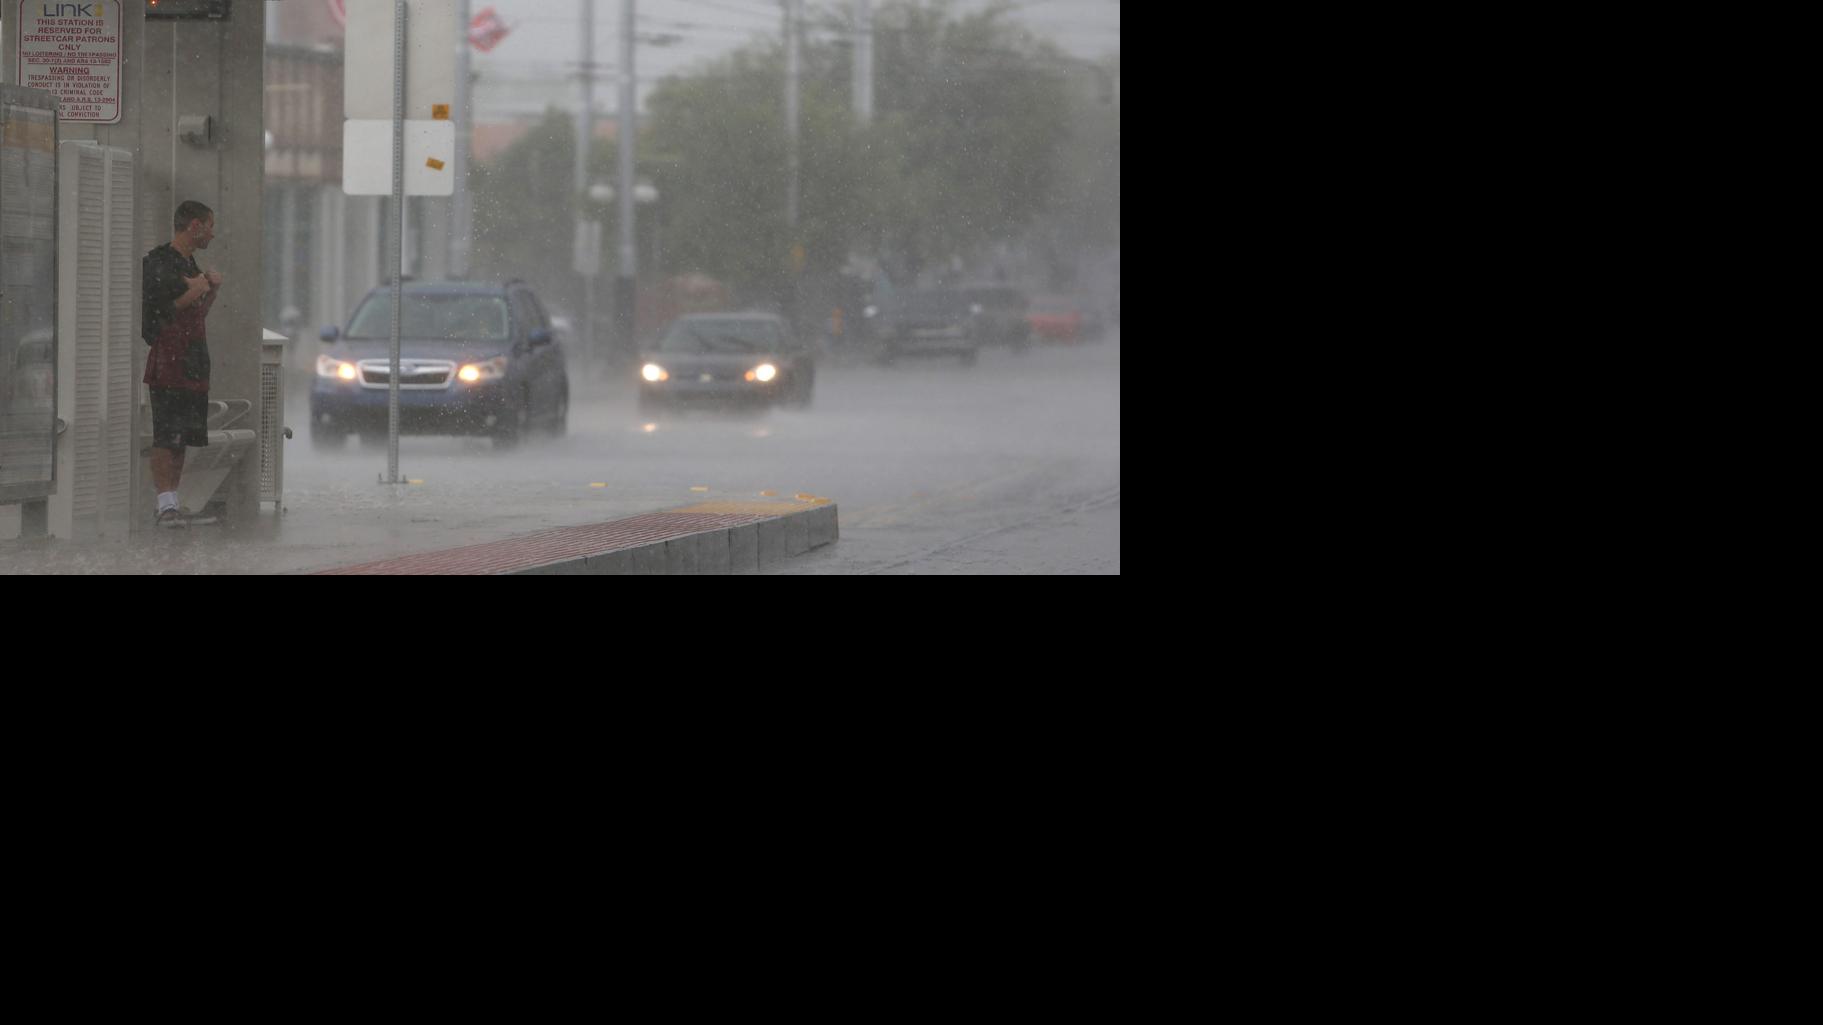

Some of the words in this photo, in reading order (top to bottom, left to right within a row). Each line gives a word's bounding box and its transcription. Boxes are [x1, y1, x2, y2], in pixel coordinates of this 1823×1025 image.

[36, 18, 55, 26] THIS
[95, 19, 104, 27] IS
[84, 27, 102, 35] FOR
[75, 35, 116, 43] PATRONS
[58, 43, 81, 51] ONLY
[49, 66, 90, 74] WARNING
